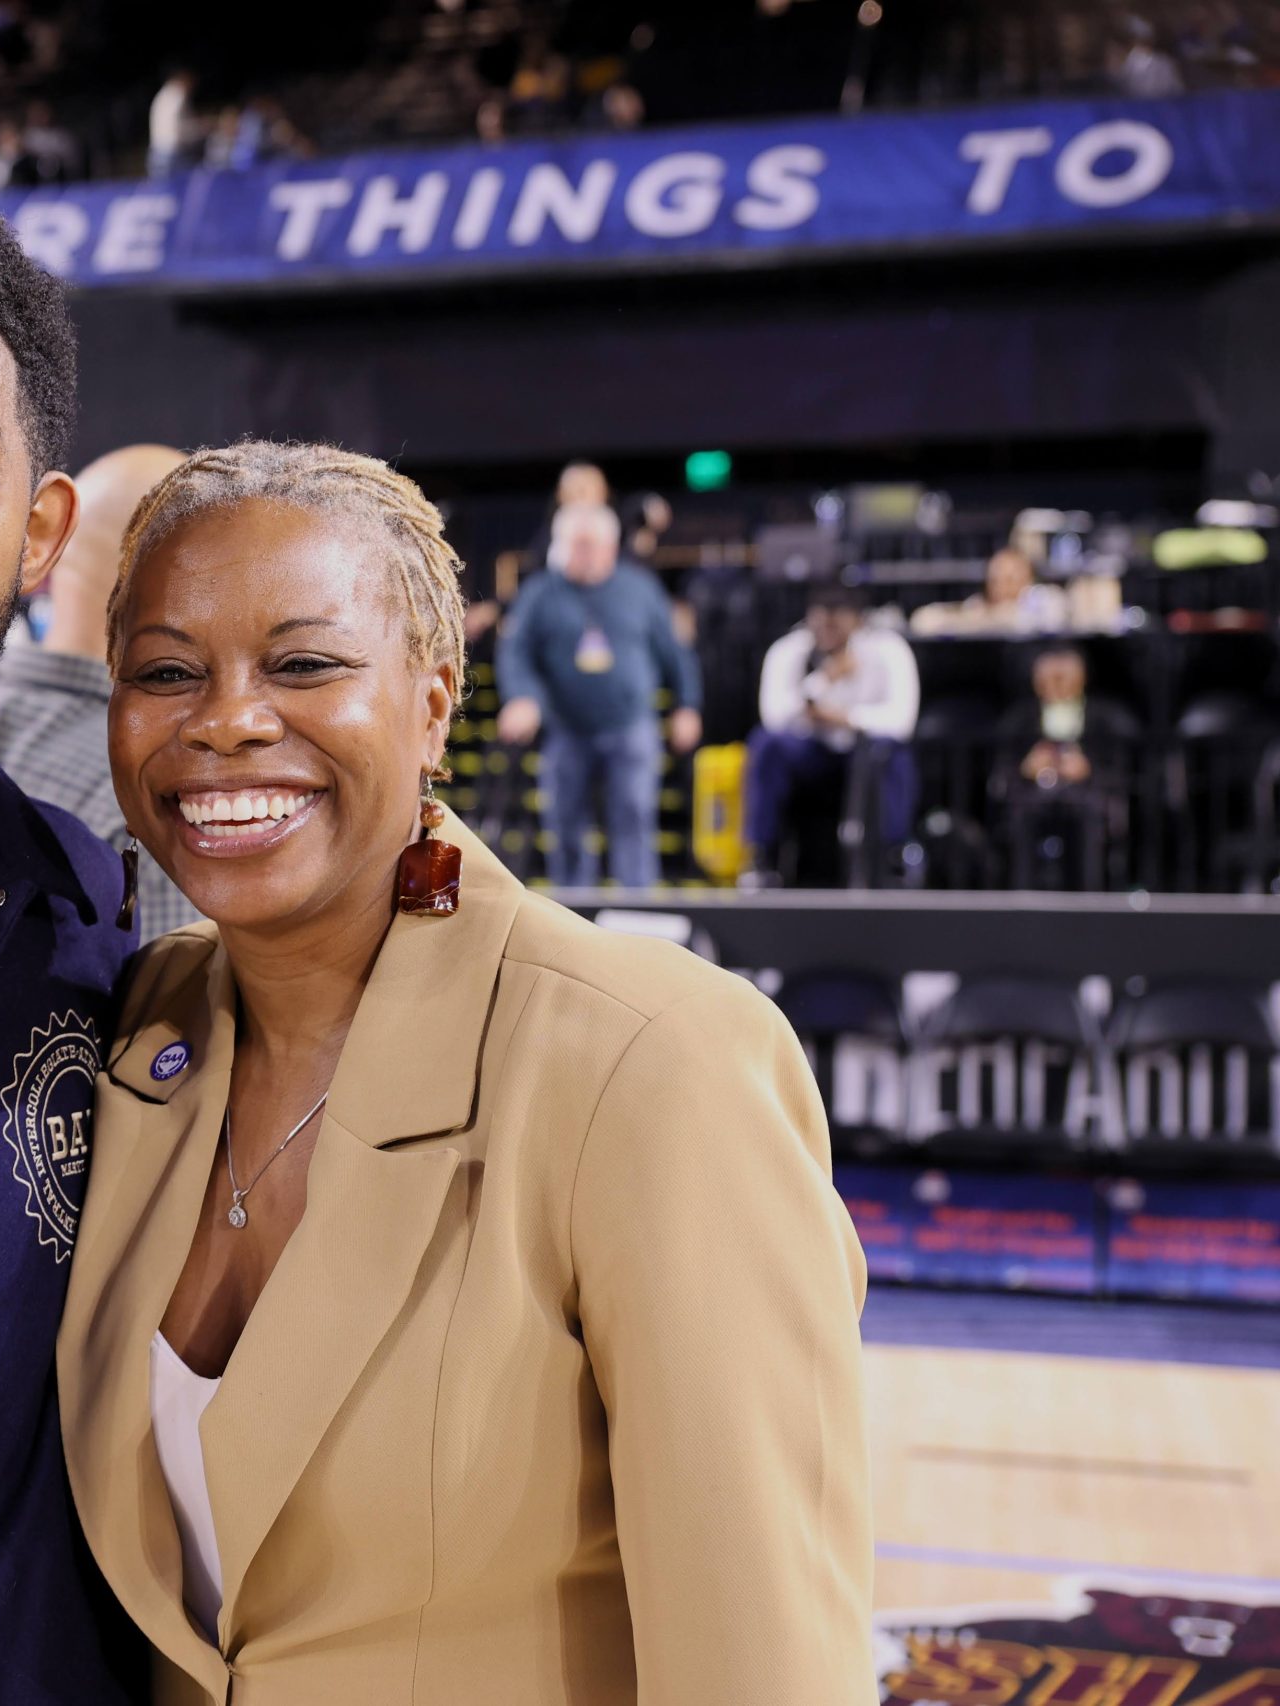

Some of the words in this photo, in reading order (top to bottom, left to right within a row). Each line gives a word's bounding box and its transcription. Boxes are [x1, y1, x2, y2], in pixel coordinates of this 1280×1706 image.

[15, 194, 177, 274] RE
[270, 145, 826, 261] THINGS
[960, 119, 1172, 214] TO
[26, 1044, 76, 1178] INTERCOLLEGIATE
[46, 1108, 91, 1161] BA
